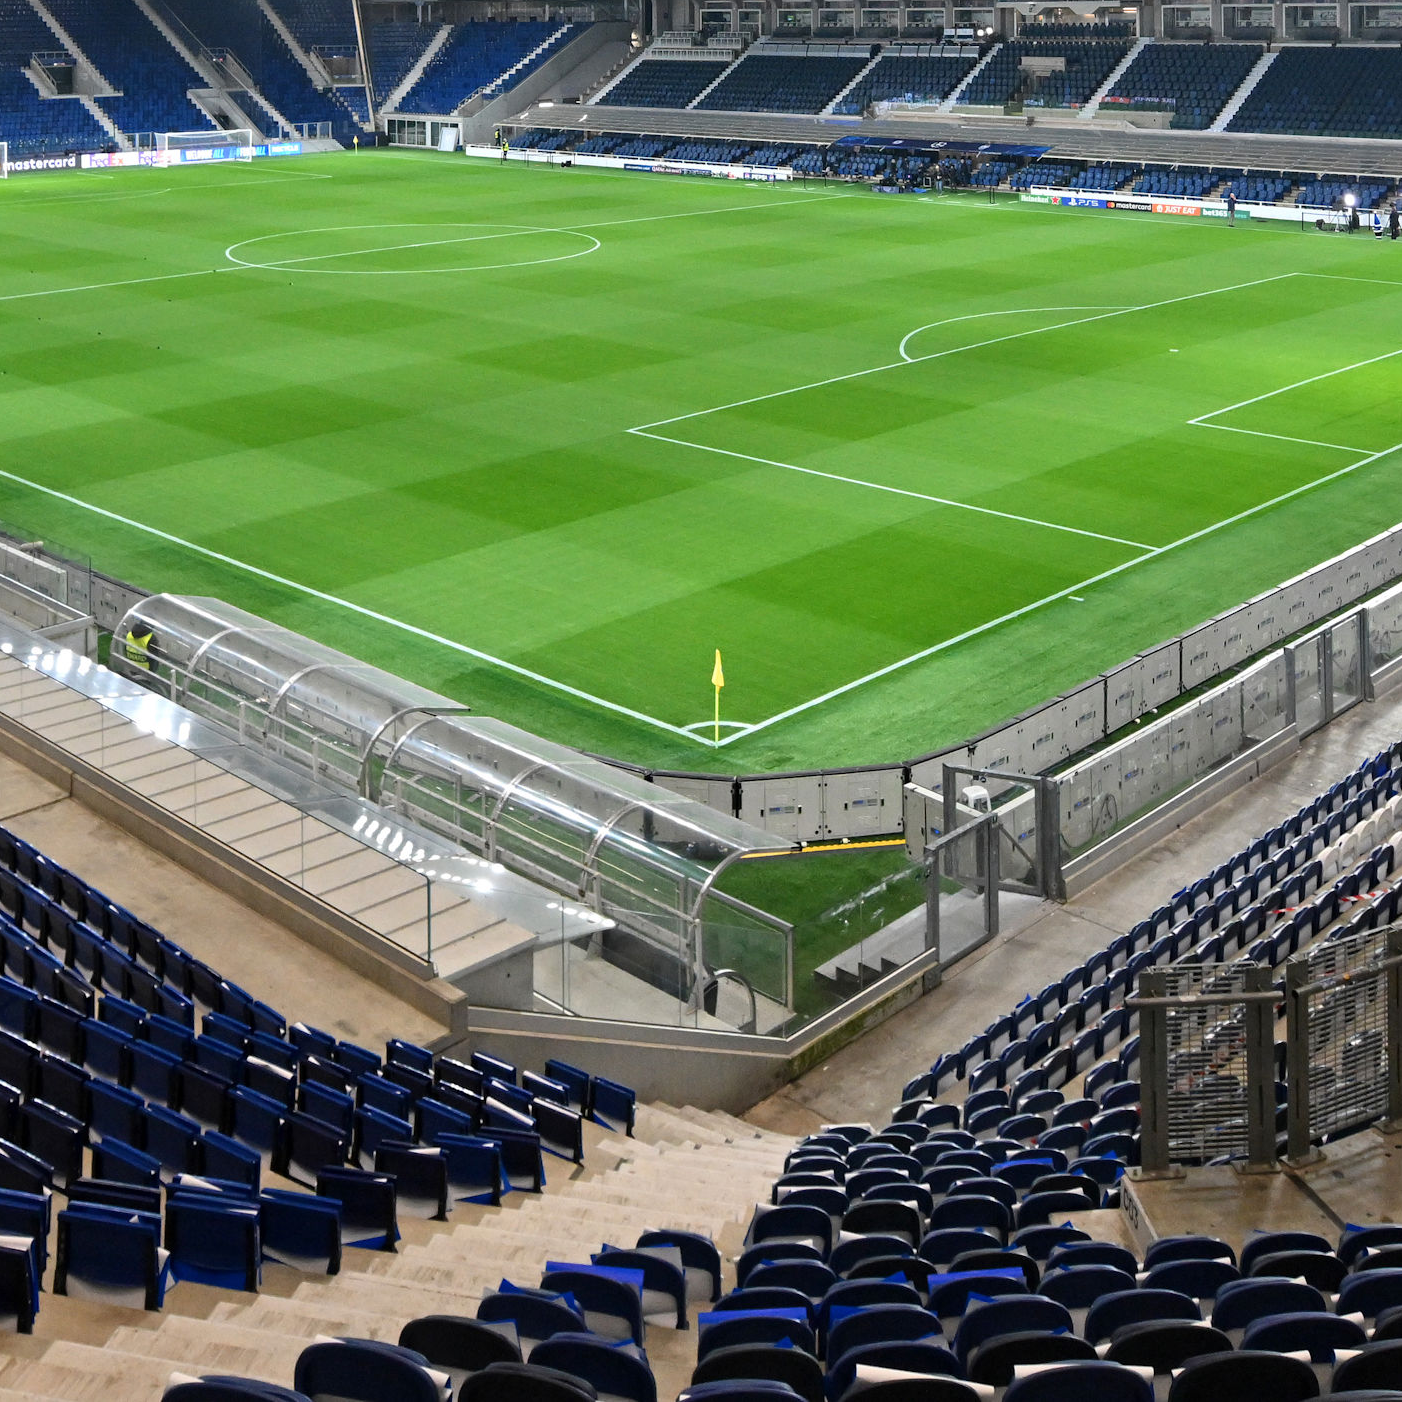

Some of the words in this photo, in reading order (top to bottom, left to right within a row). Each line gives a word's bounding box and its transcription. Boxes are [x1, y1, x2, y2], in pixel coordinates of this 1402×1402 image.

[3, 157, 76, 172] mastercard
[89, 153, 123, 167] FedEx
[1078, 197, 1099, 207] PS5
[1115, 201, 1152, 211] mastercard
[1165, 205, 1182, 214] JUST
[1183, 206, 1197, 214] EAT
[1202, 208, 1228, 217] bet365
